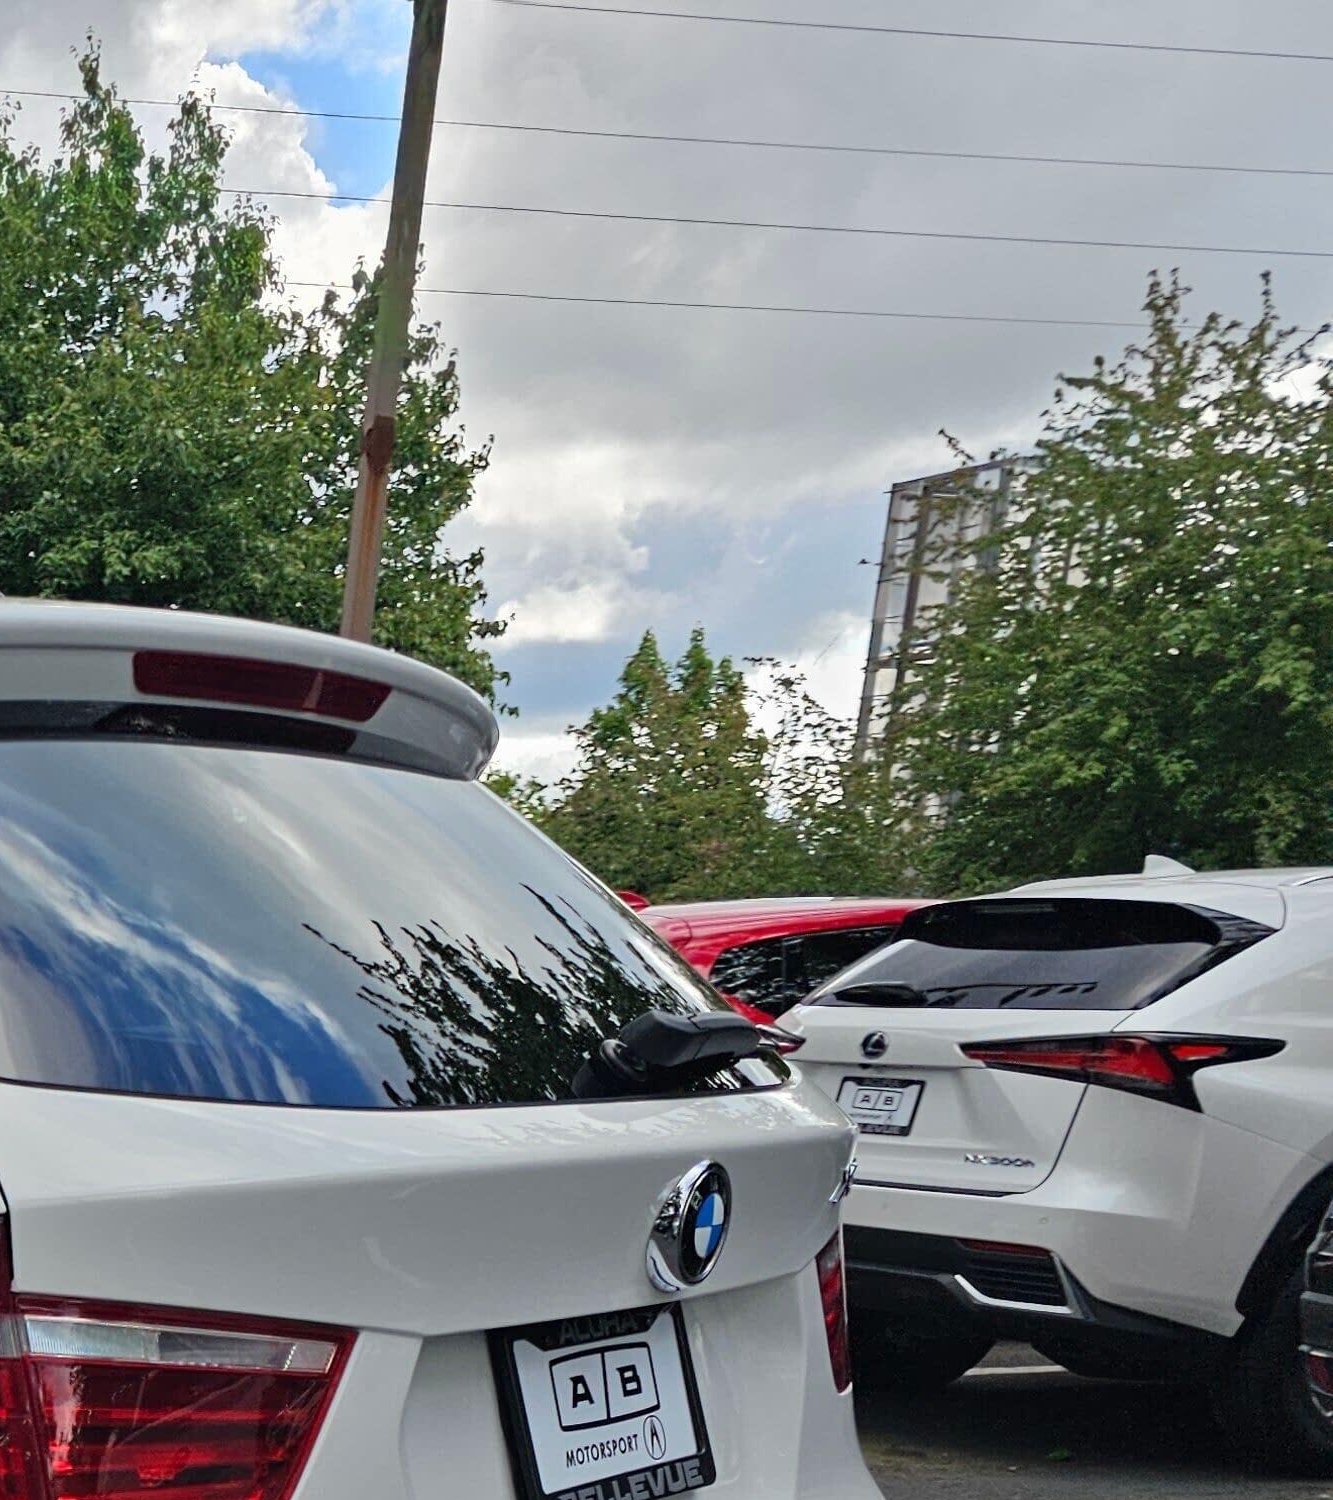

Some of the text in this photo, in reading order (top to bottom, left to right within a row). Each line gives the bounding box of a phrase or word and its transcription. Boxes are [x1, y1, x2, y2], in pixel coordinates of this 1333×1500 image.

[883, 1096, 894, 1106] B
[569, 1364, 643, 1409] A B
[565, 1433, 639, 1469] MOTORSPORT
